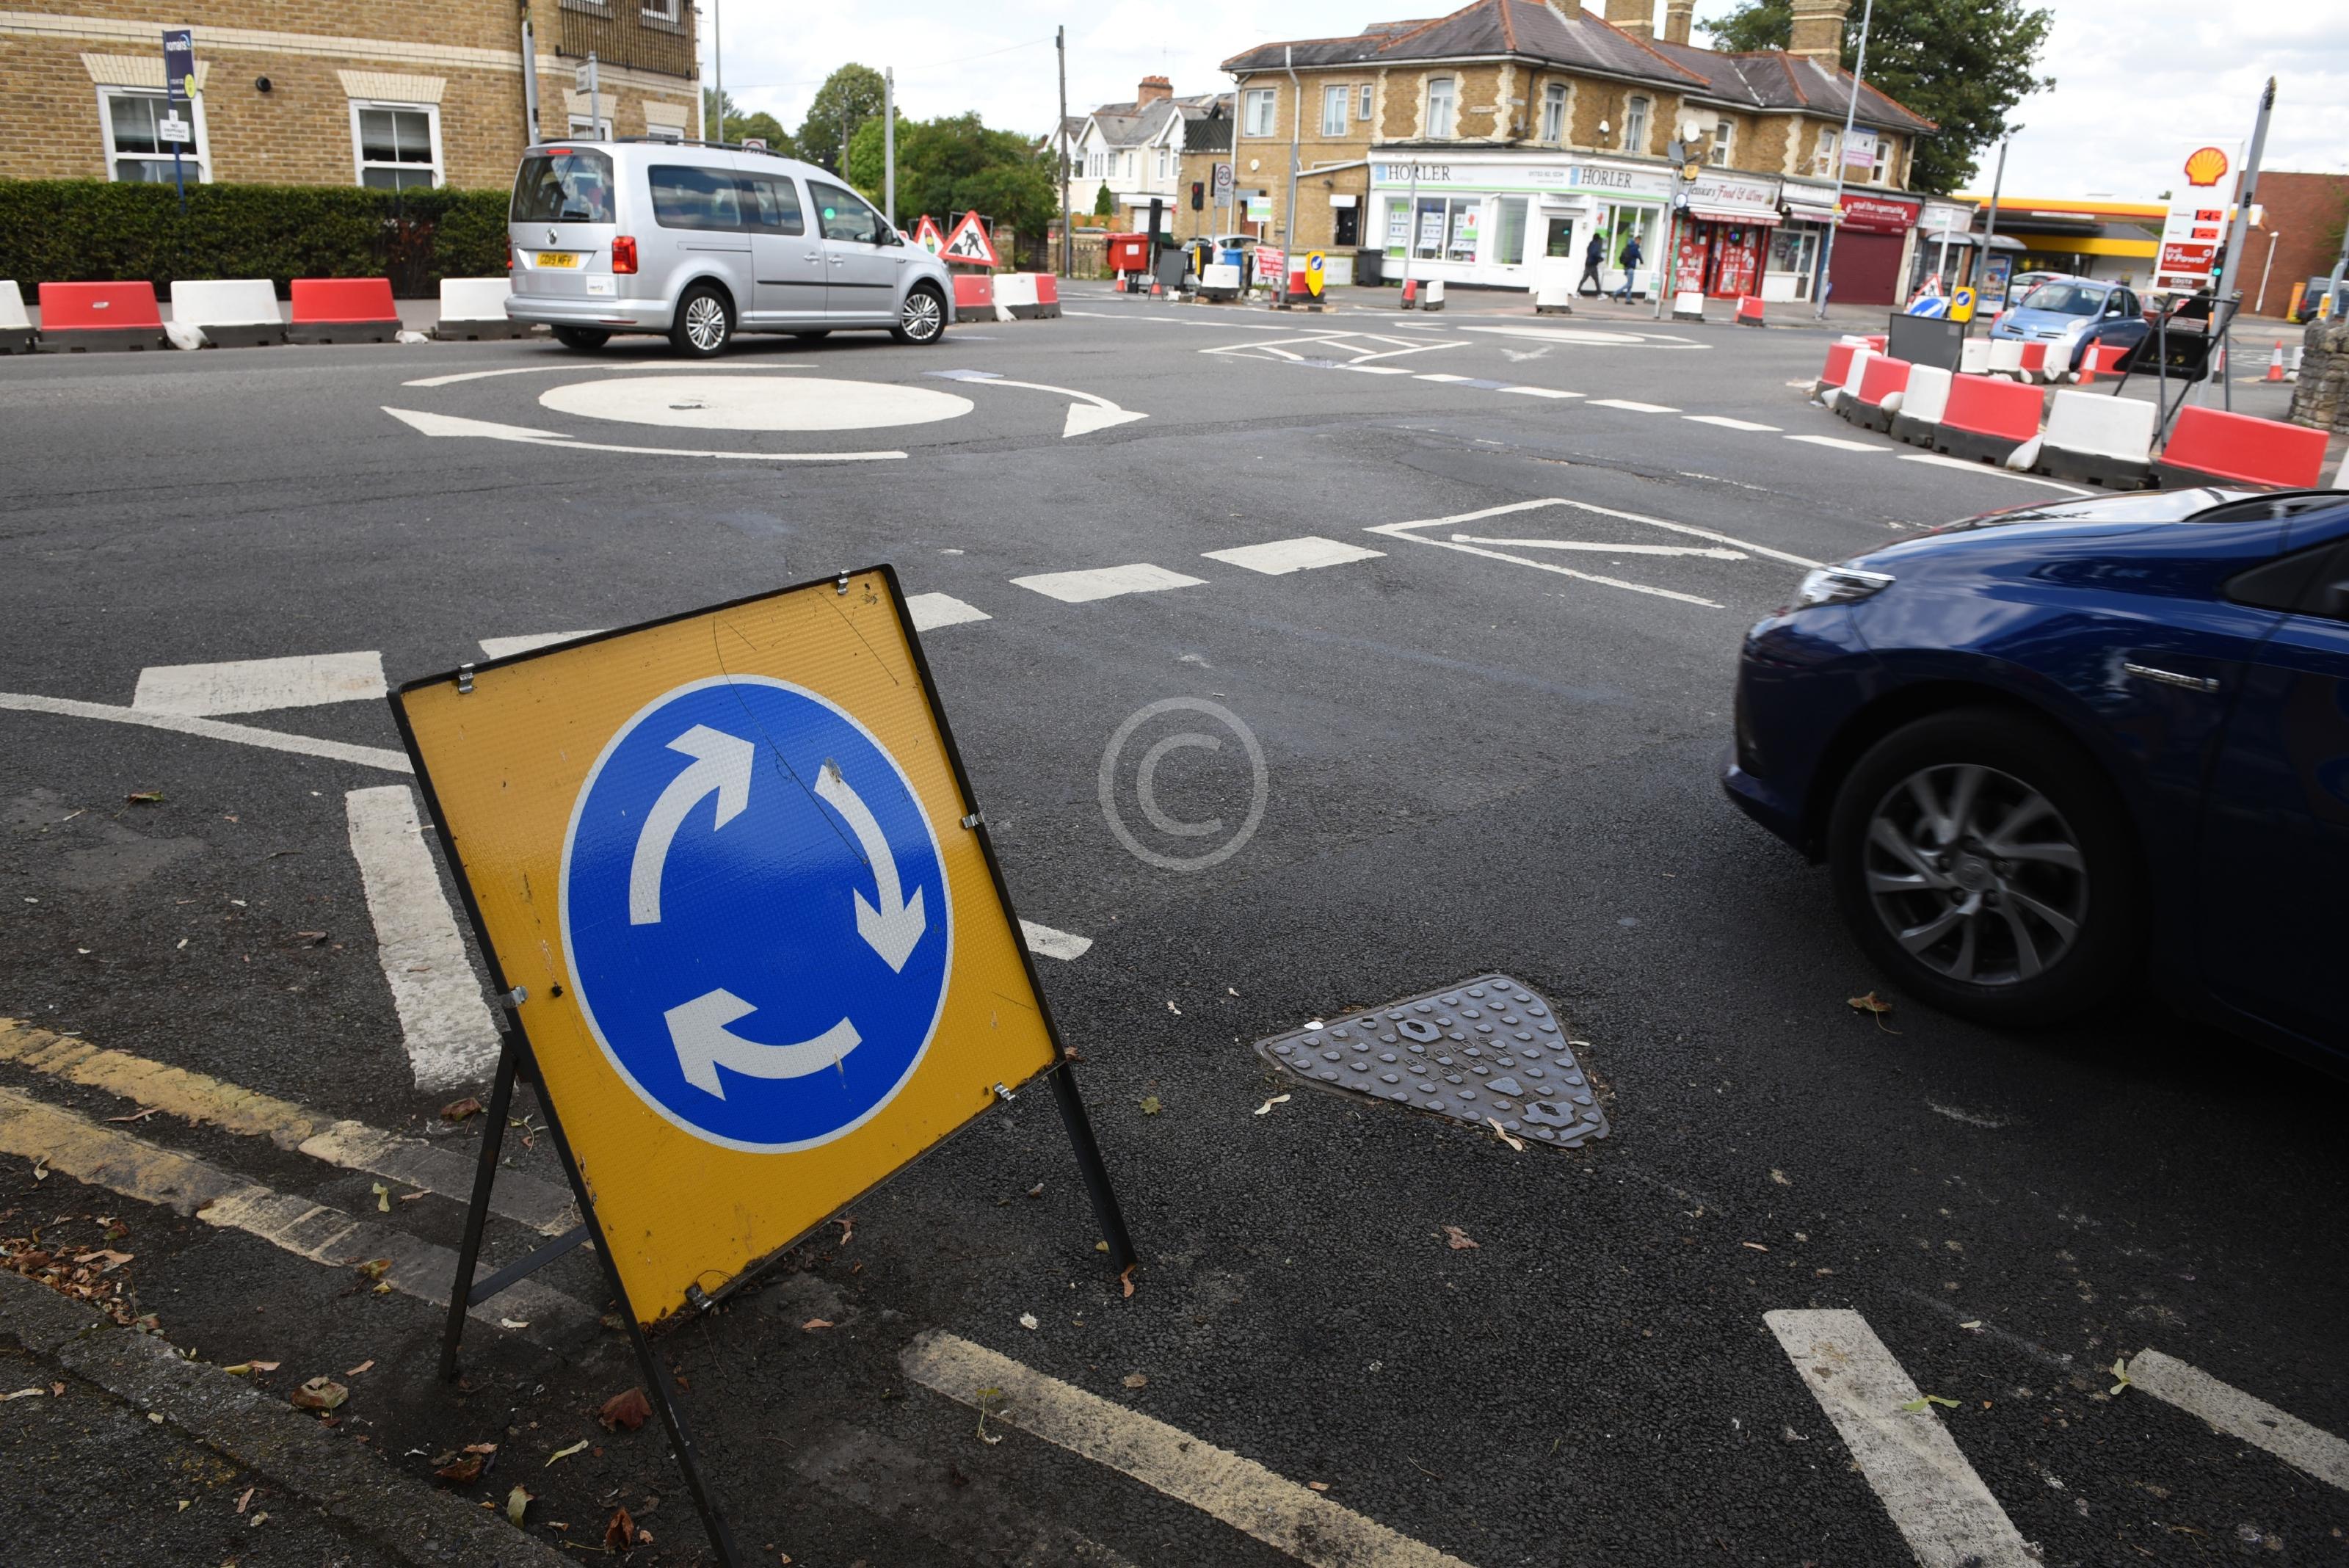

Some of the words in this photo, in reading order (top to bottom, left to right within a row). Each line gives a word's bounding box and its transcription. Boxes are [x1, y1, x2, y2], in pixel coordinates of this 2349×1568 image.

[1219, 170, 1229, 180] 20
[1388, 164, 1451, 181] HORLER
[1581, 168, 1632, 189] HORLER
[1715, 184, 1737, 201] Food
[2165, 253, 2208, 264] V-Power
[1404, 1035, 1491, 1066] BROADS
[1423, 1048, 1513, 1081] LONDON
